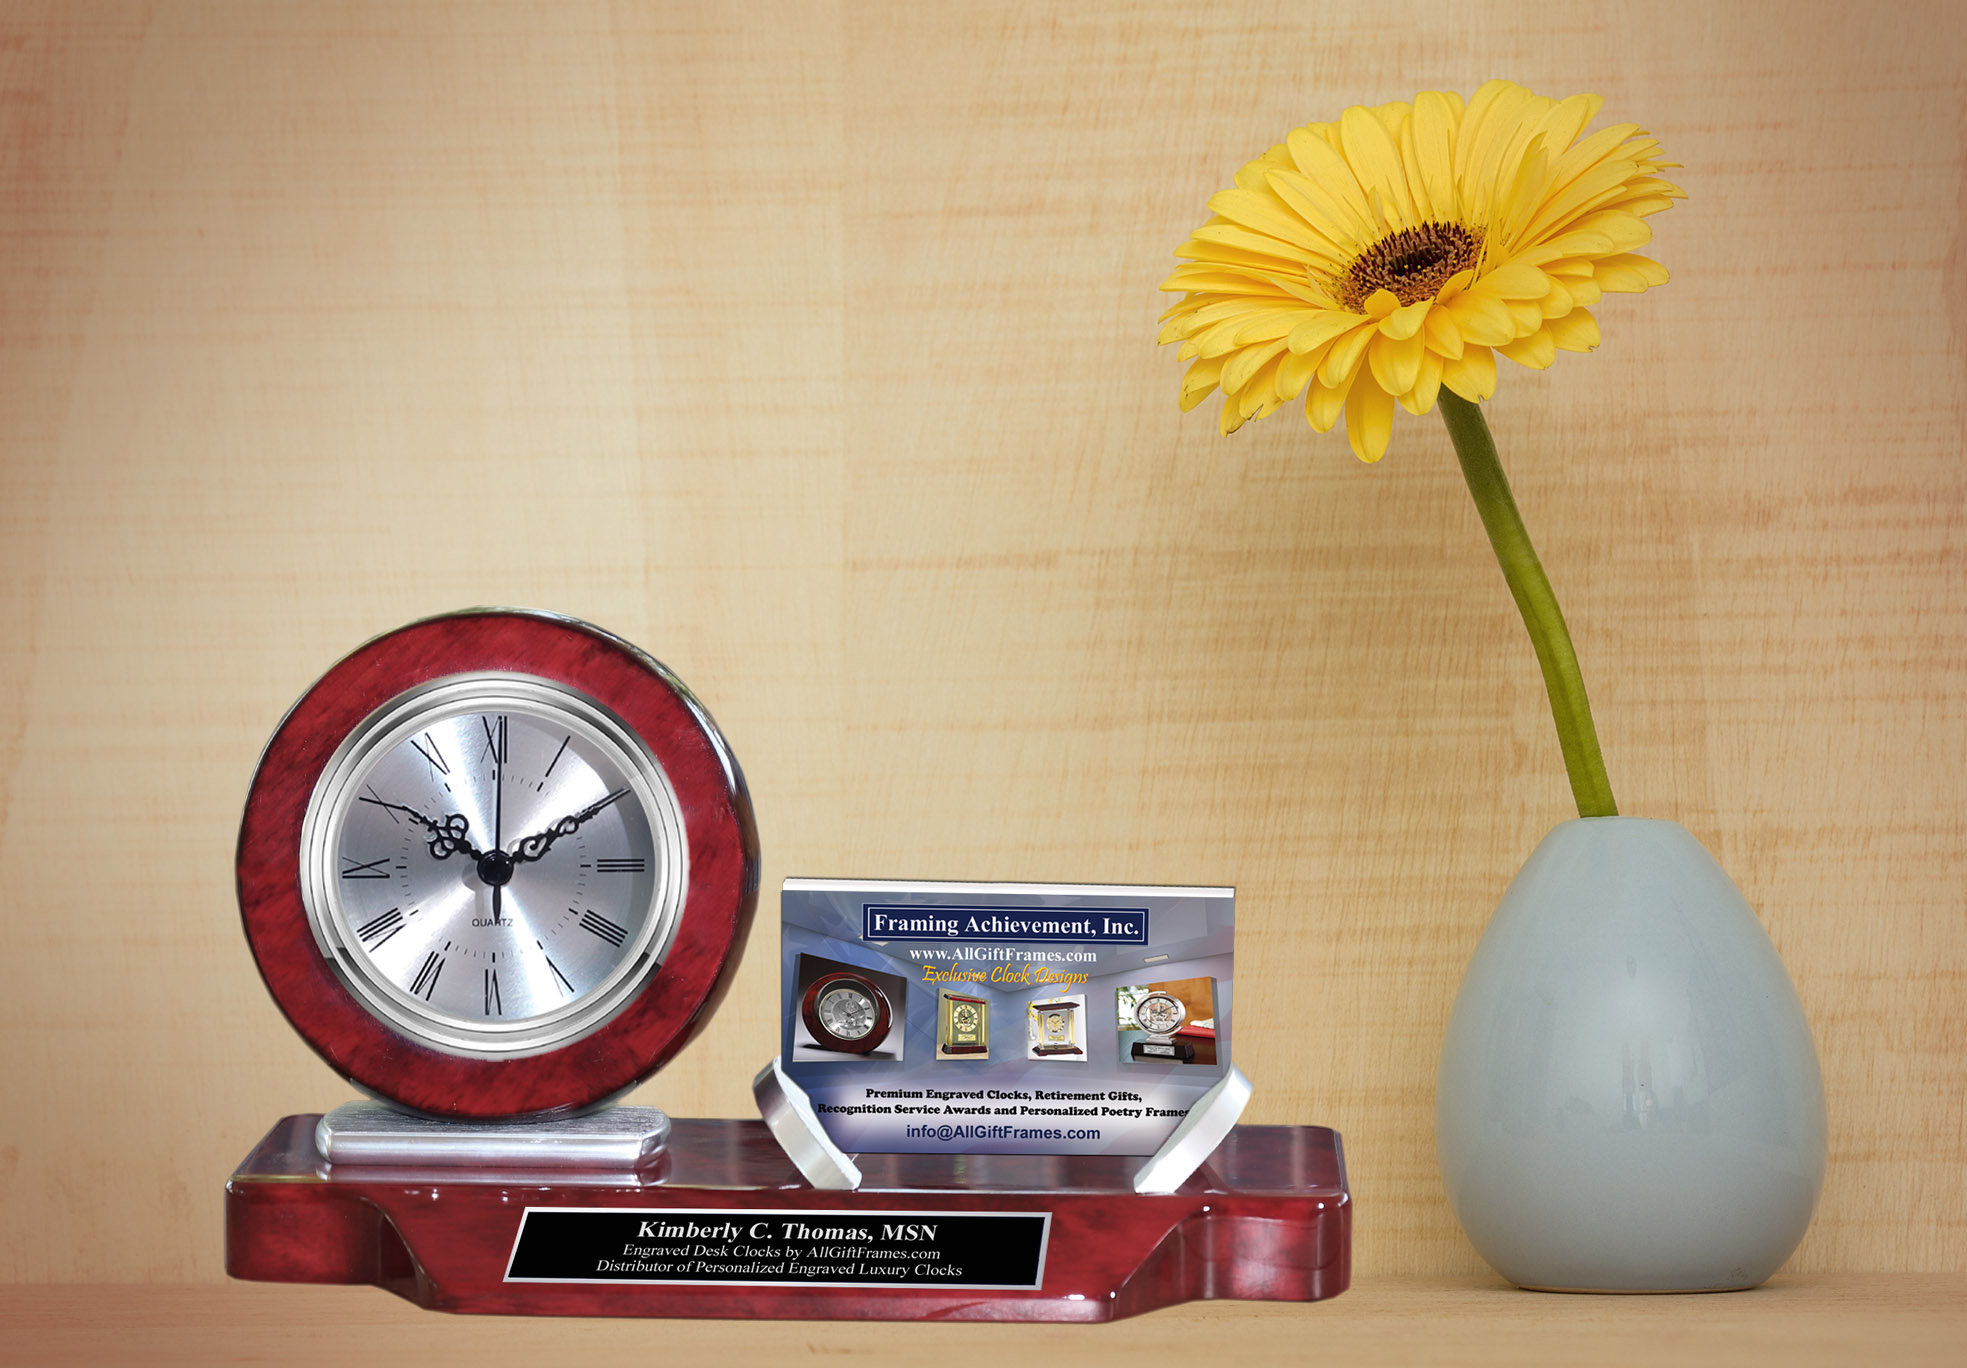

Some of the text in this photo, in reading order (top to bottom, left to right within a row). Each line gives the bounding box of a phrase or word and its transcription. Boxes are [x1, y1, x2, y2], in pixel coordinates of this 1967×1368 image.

[481, 715, 507, 764] XI
[471, 918, 514, 928] QUARTZ
[874, 914, 1140, 938] Framing Achievement, Inc.
[909, 947, 1097, 962] www.AllGiftFrames.com
[922, 962, 1089, 993] Exclusive Clock Designs
[866, 1088, 1142, 1103] Premium Engraved Clocks, Retirement Gifts,
[817, 1103, 891, 1116] Recognition
[894, 1104, 940, 1115] Service
[943, 1105, 991, 1115] Awards
[994, 1105, 1017, 1115] and
[1020, 1105, 1098, 1117] Personalized
[1101, 1106, 1142, 1119] Poetry
[906, 1124, 1101, 1142] info@AllGiftFrames.com
[637, 1221, 939, 1244] Kimberly C. Thomas, MSN
[622, 1243, 941, 1260] Engraved Desk Clocks by AllGiftFrames.com
[596, 1259, 964, 1278] Distributor of Personalized Engraved Luxury Clocks
